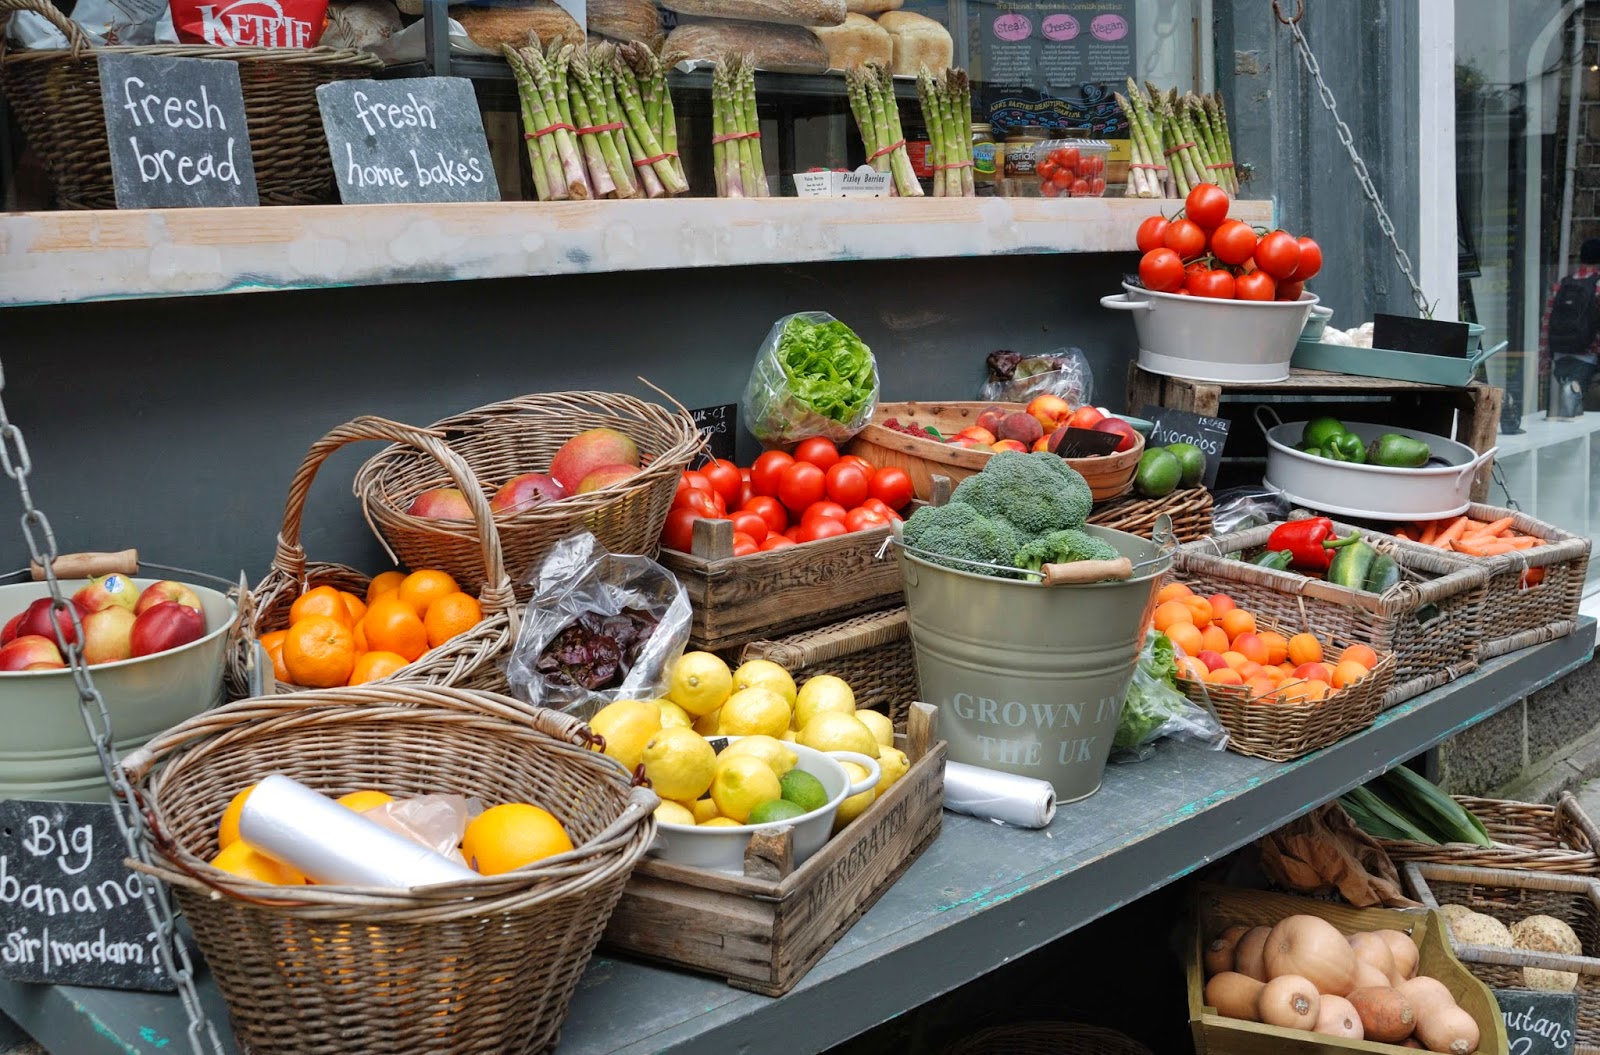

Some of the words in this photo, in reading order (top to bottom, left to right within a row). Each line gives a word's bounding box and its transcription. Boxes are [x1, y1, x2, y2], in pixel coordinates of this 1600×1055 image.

[1044, 21, 1075, 34] Cheese
[1092, 21, 1124, 34] Vegan
[123, 77, 227, 131] fresh
[355, 91, 437, 136] fresh
[130, 136, 241, 186] bread
[346, 143, 408, 188] home
[410, 149, 484, 188] bakes
[842, 173, 861, 185] Pixley
[864, 173, 885, 183] Berries
[1150, 420, 1217, 455] Avocados
[953, 692, 1087, 729] GROWN
[1094, 696, 1121, 724] IN
[977, 735, 1043, 766] THE
[1058, 736, 1097, 765] UK
[23, 815, 93, 875] Big
[807, 795, 910, 924] MARGRATEN
